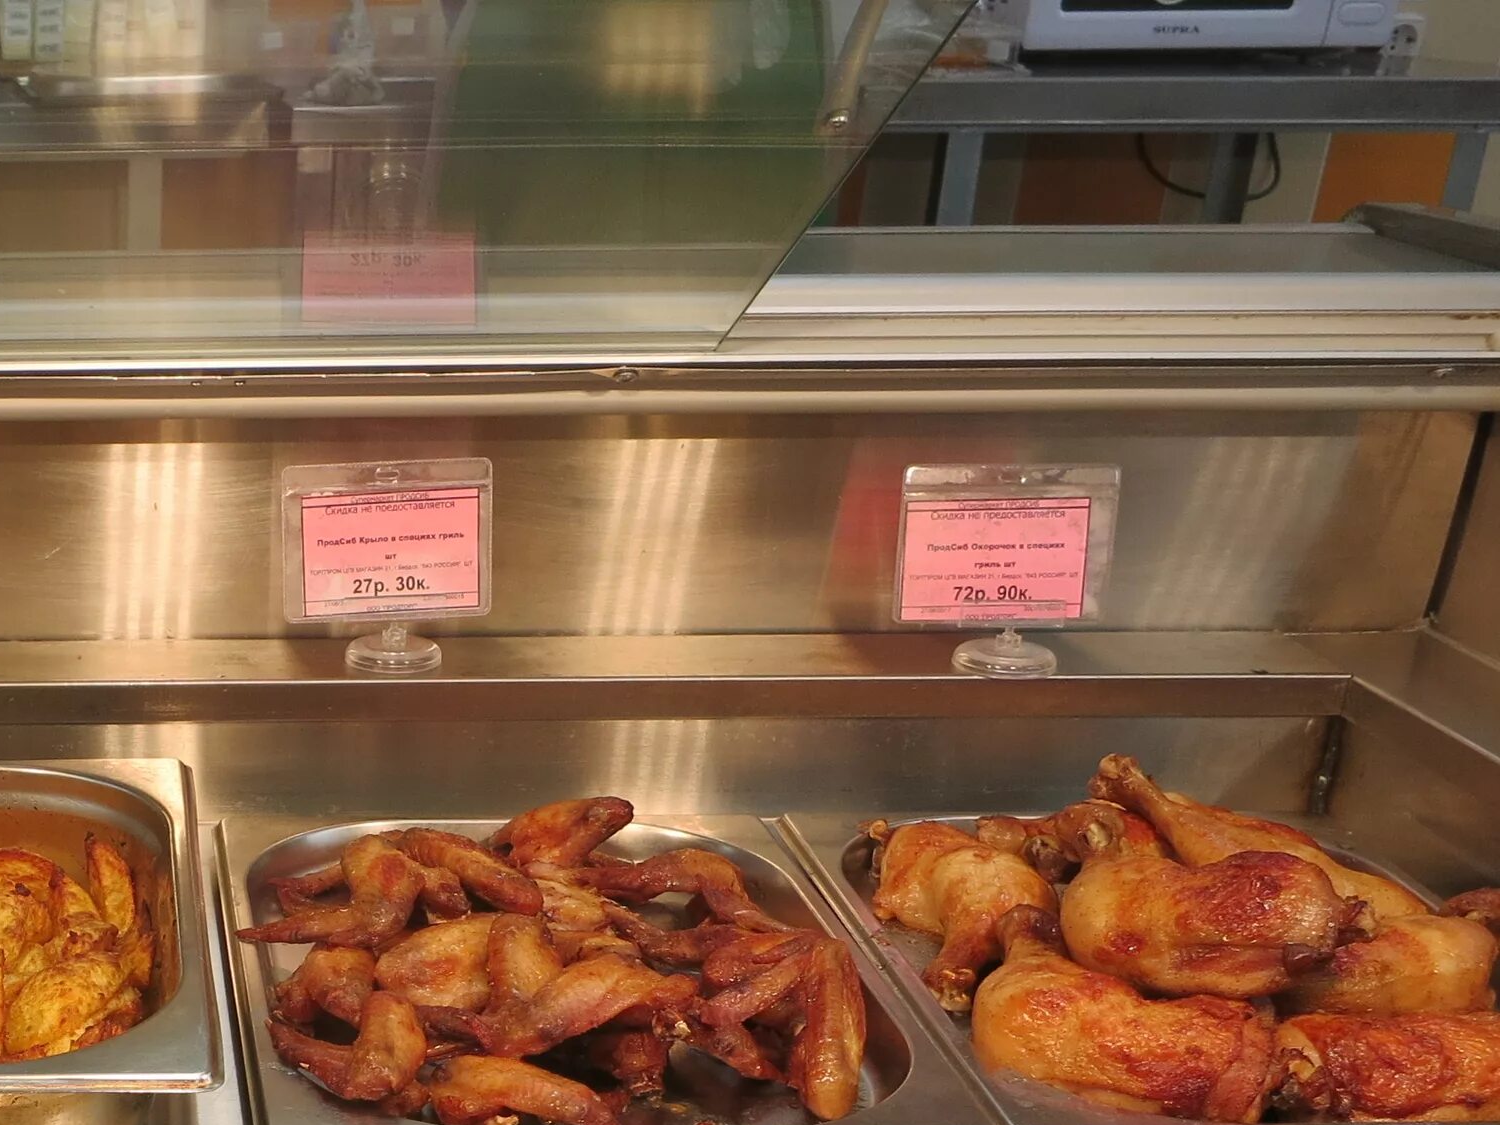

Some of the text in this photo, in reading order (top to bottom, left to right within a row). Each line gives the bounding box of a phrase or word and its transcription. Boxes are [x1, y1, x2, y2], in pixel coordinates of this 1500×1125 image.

[1153, 24, 1200, 34] SUPRA
[325, 501, 456, 516] Скидка не предоставляется
[930, 509, 1065, 521] Скидка не предоставляется
[317, 537, 357, 547] ПродСиб
[359, 536, 389, 545] Крыло
[399, 534, 436, 542] специях
[438, 531, 464, 541] гриль
[927, 543, 969, 552] ПродСиб
[971, 543, 1016, 552] Окорочок
[1027, 542, 1065, 550] специях
[974, 562, 1001, 570] гриль
[353, 576, 430, 596] 27р. 30к.
[952, 585, 1033, 604] 72р. 90к.
